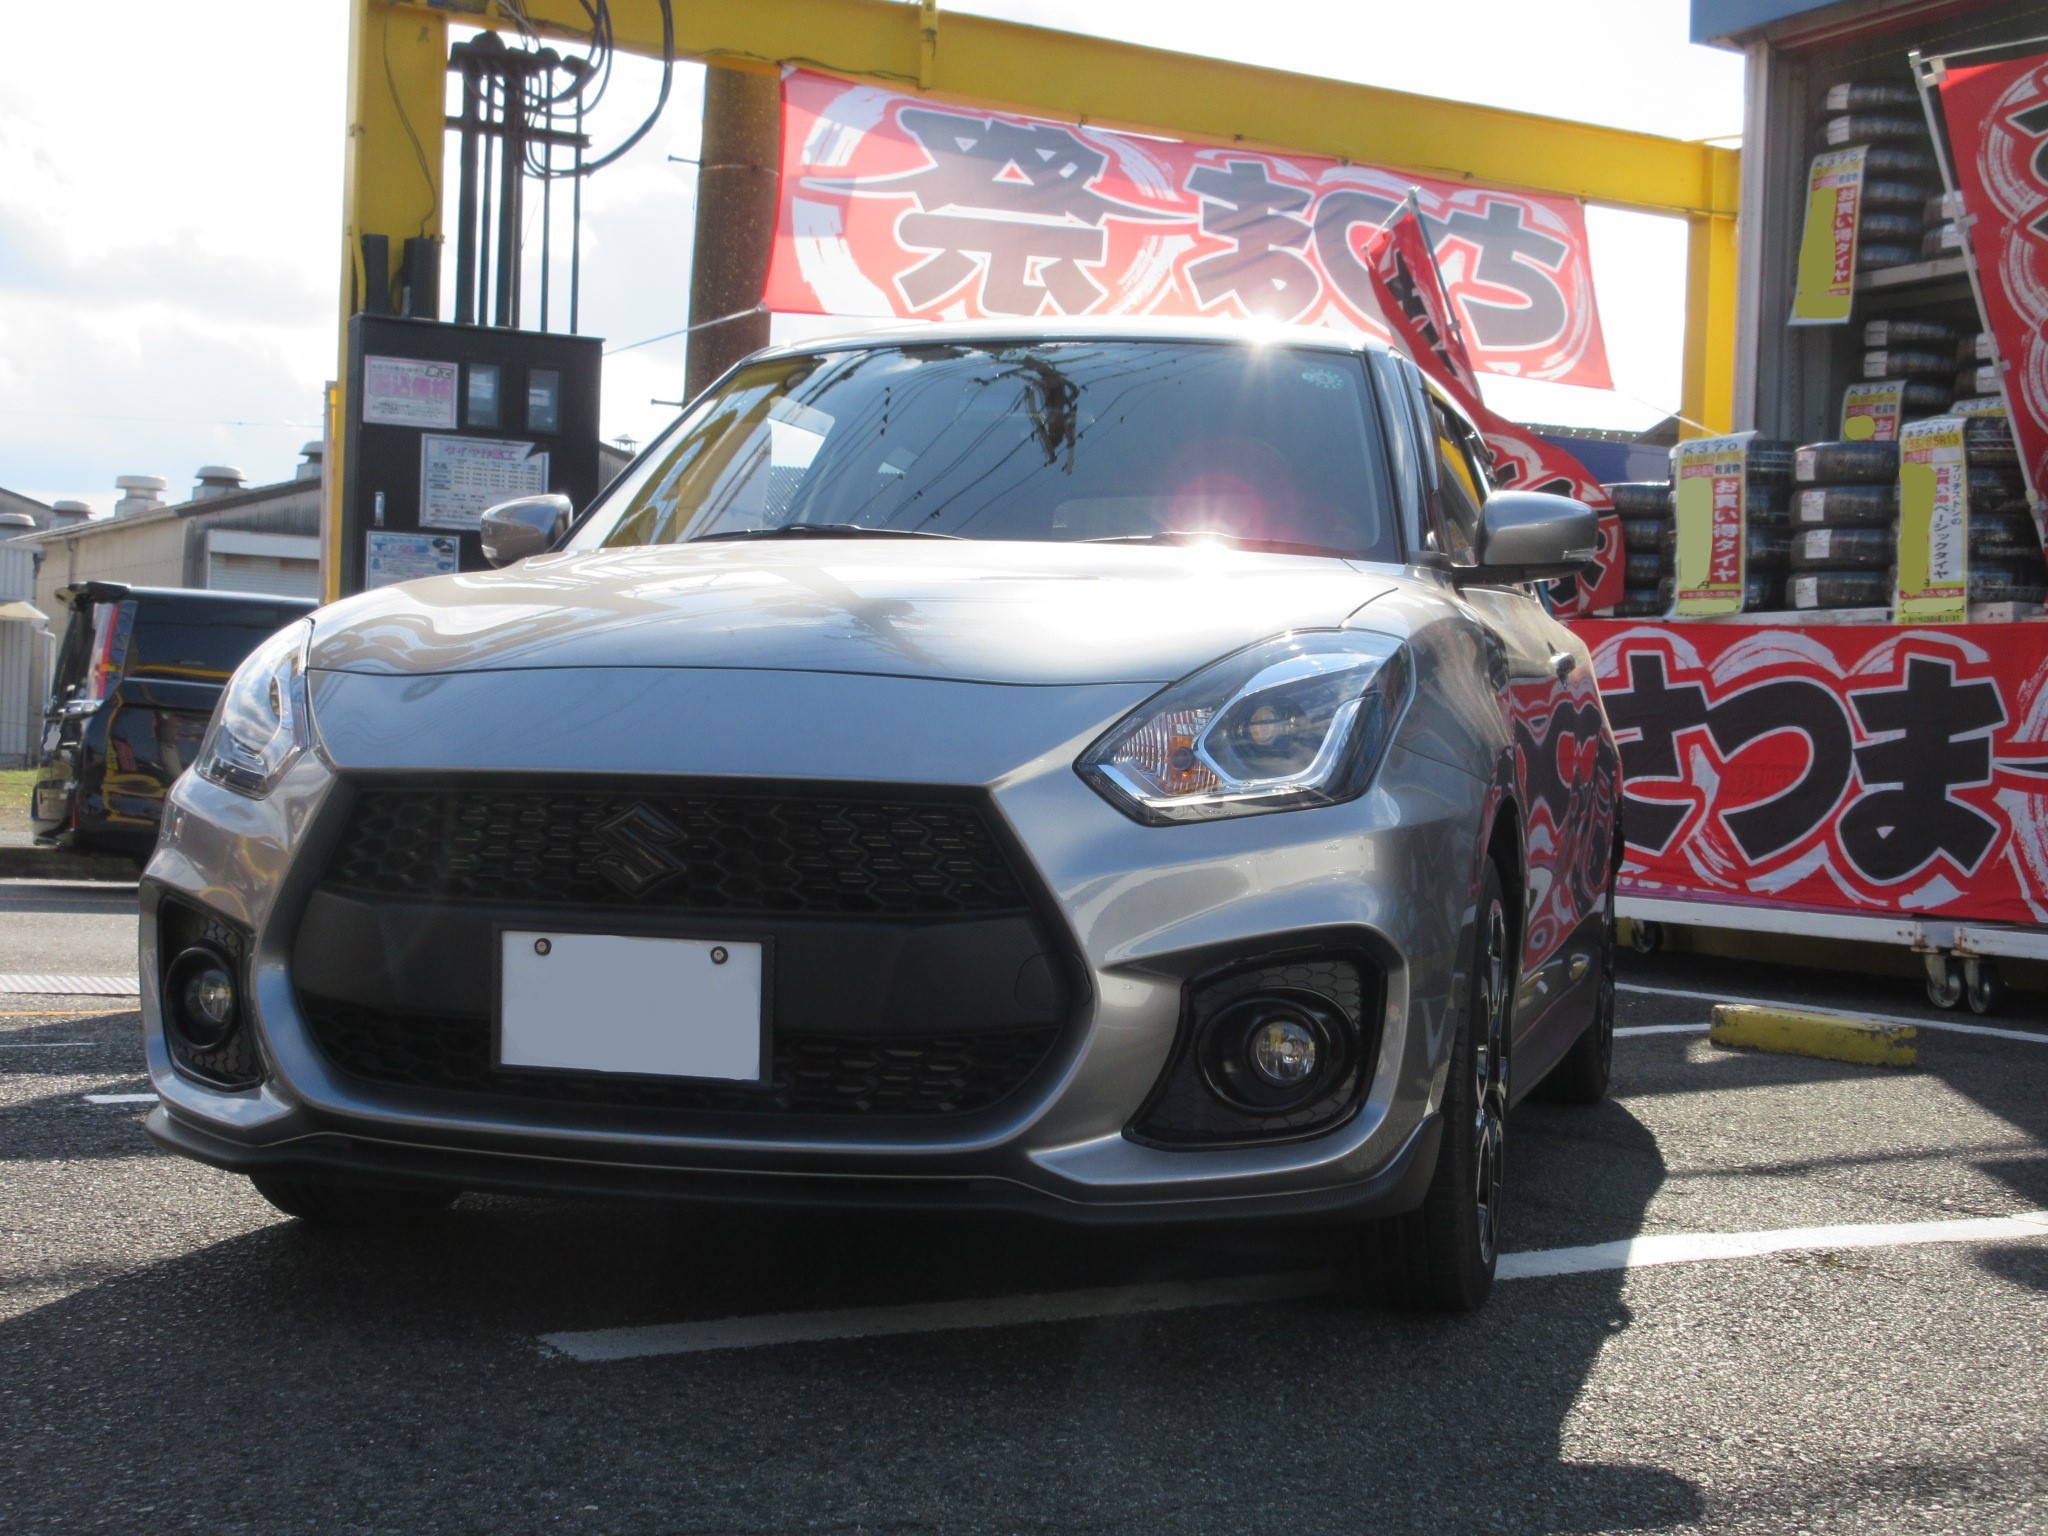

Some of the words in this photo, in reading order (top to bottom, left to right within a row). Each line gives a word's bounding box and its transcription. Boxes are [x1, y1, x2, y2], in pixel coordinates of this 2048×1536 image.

[1684, 442, 1738, 455] K370
[1713, 480, 1739, 582] お買い得タイヤ
